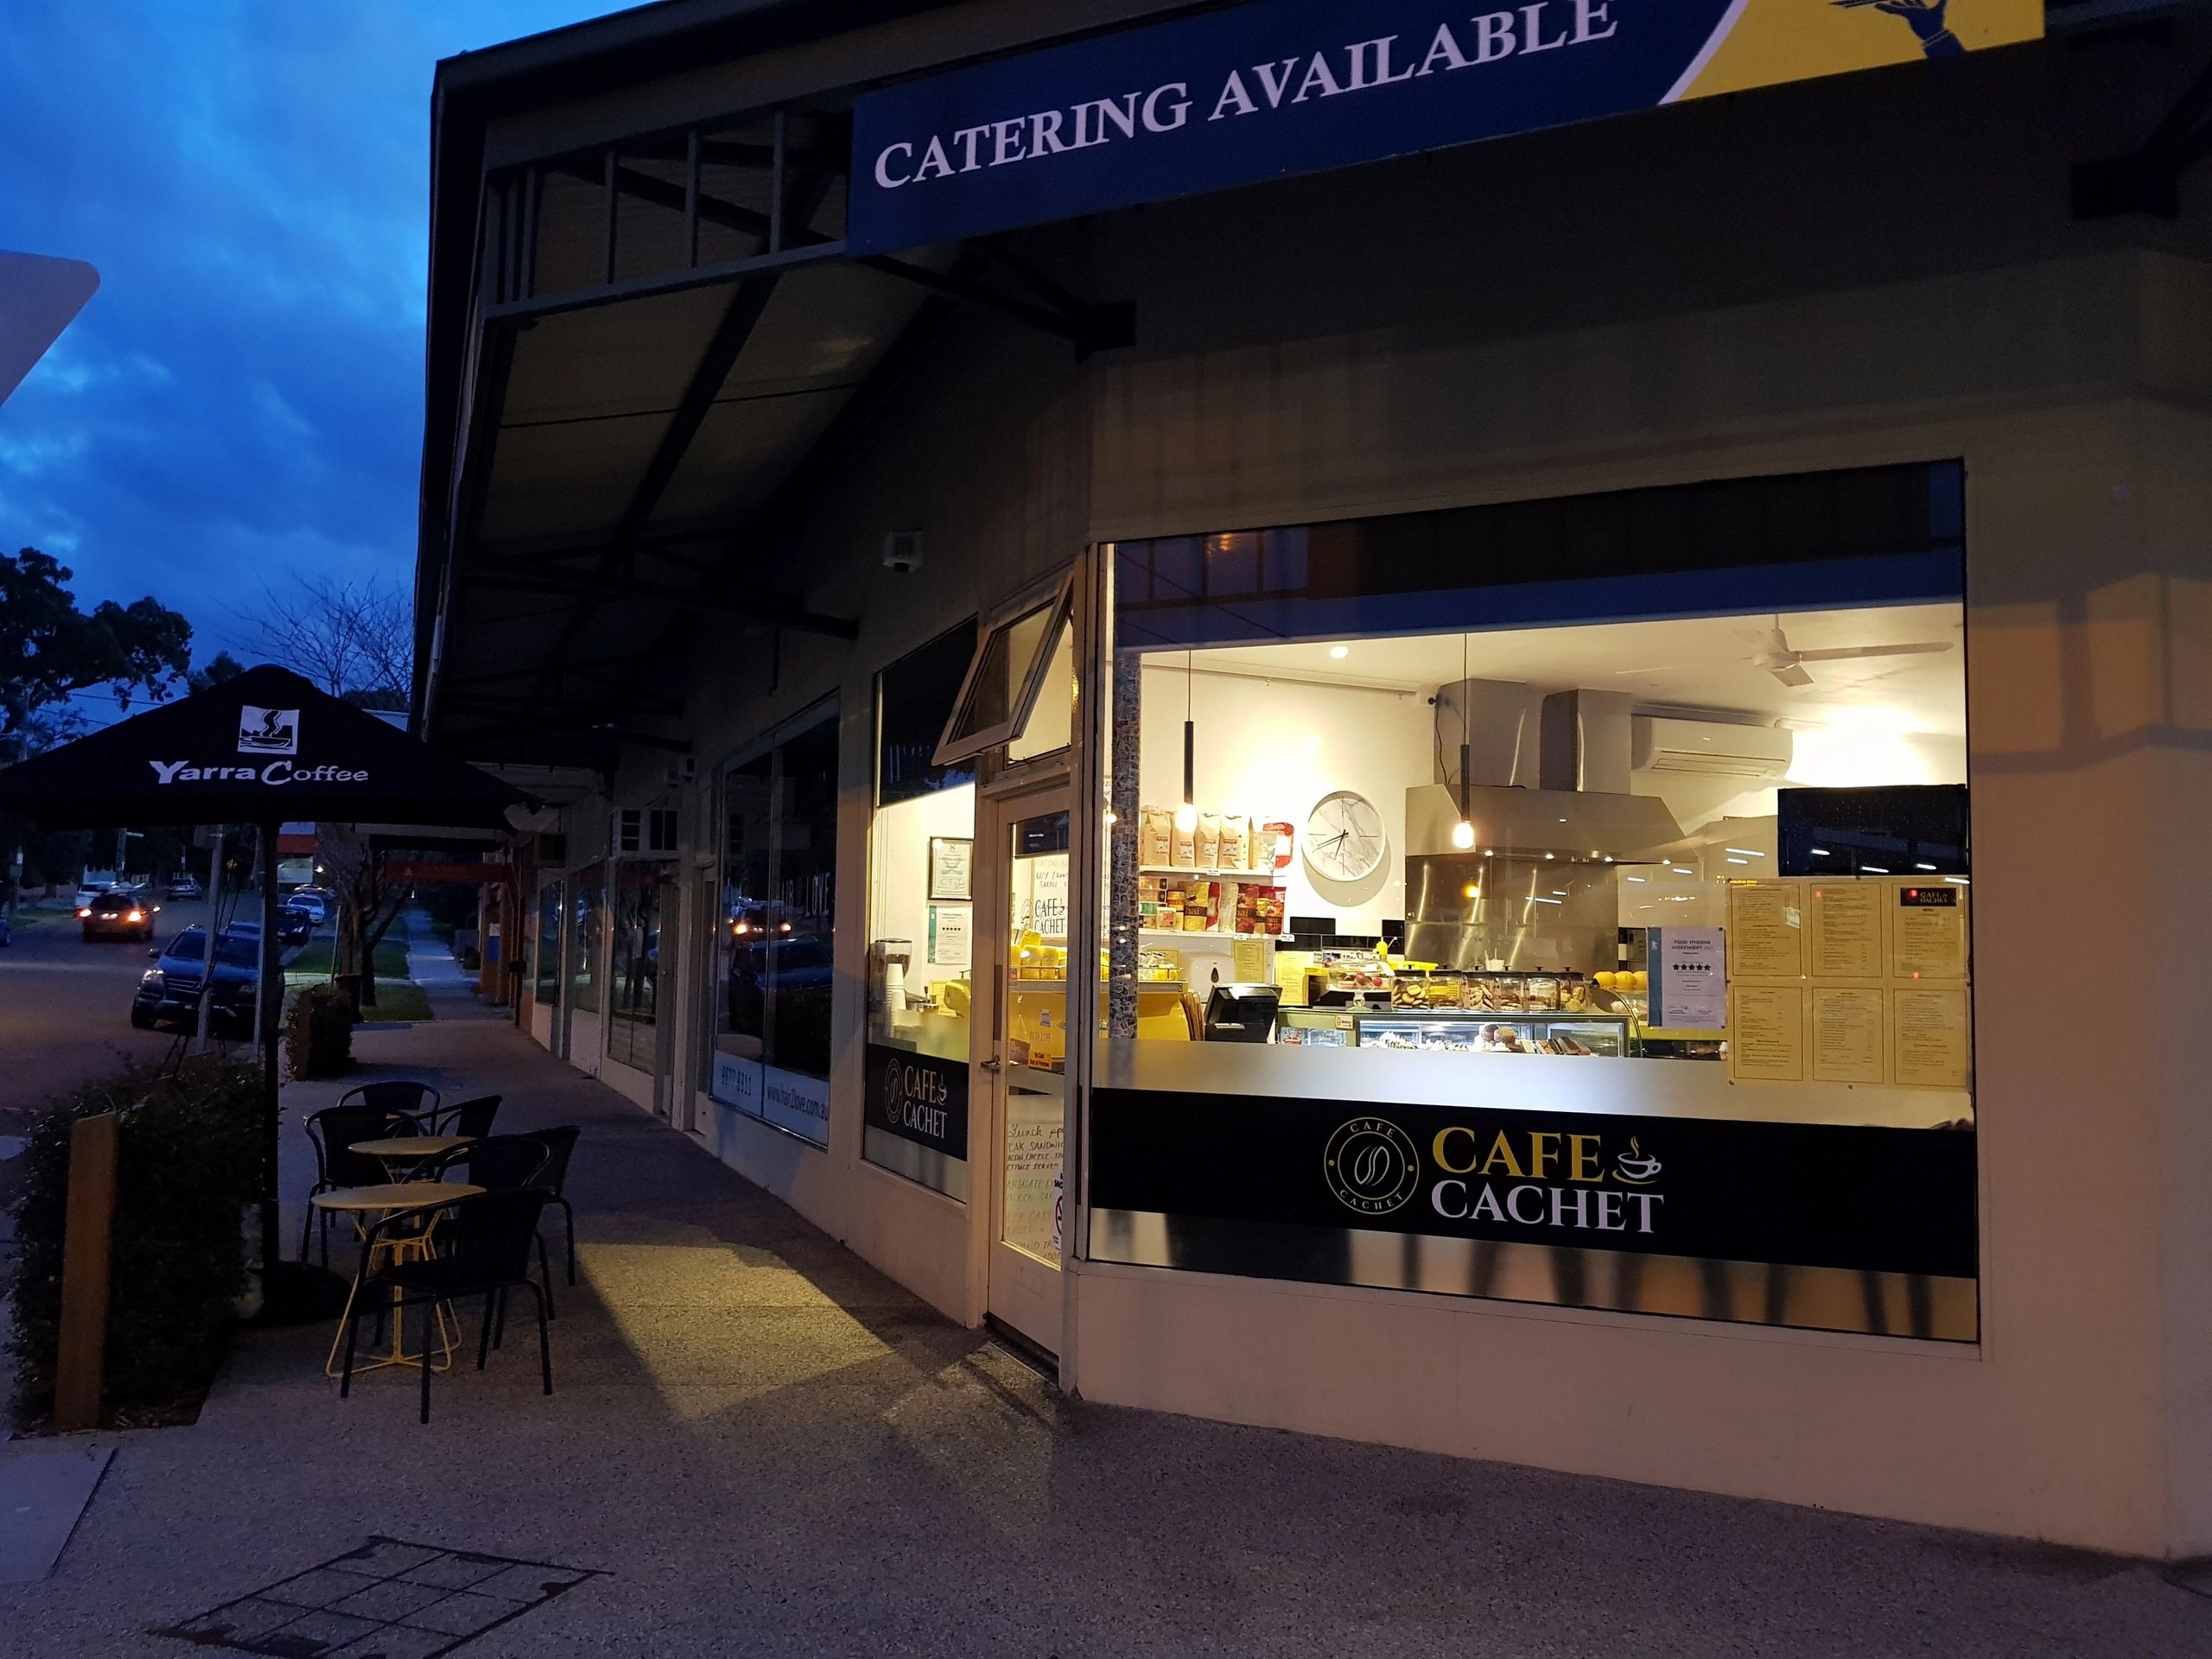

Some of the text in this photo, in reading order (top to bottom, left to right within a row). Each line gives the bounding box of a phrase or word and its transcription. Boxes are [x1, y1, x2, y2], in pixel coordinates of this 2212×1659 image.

[874, 0, 1618, 189] CATERING AVAILABLE
[149, 760, 369, 785] Yarra Coffee
[1035, 899, 1058, 918] CAFE
[1034, 918, 1065, 934] CACHET
[904, 1065, 937, 1103] CAFE
[903, 1101, 948, 1139] CACHET
[1350, 1122, 1395, 1138] CAFE
[1433, 1127, 1605, 1183] CAFE
[1340, 1190, 1403, 1210] CACHET
[1432, 1179, 1664, 1233] CACHET
